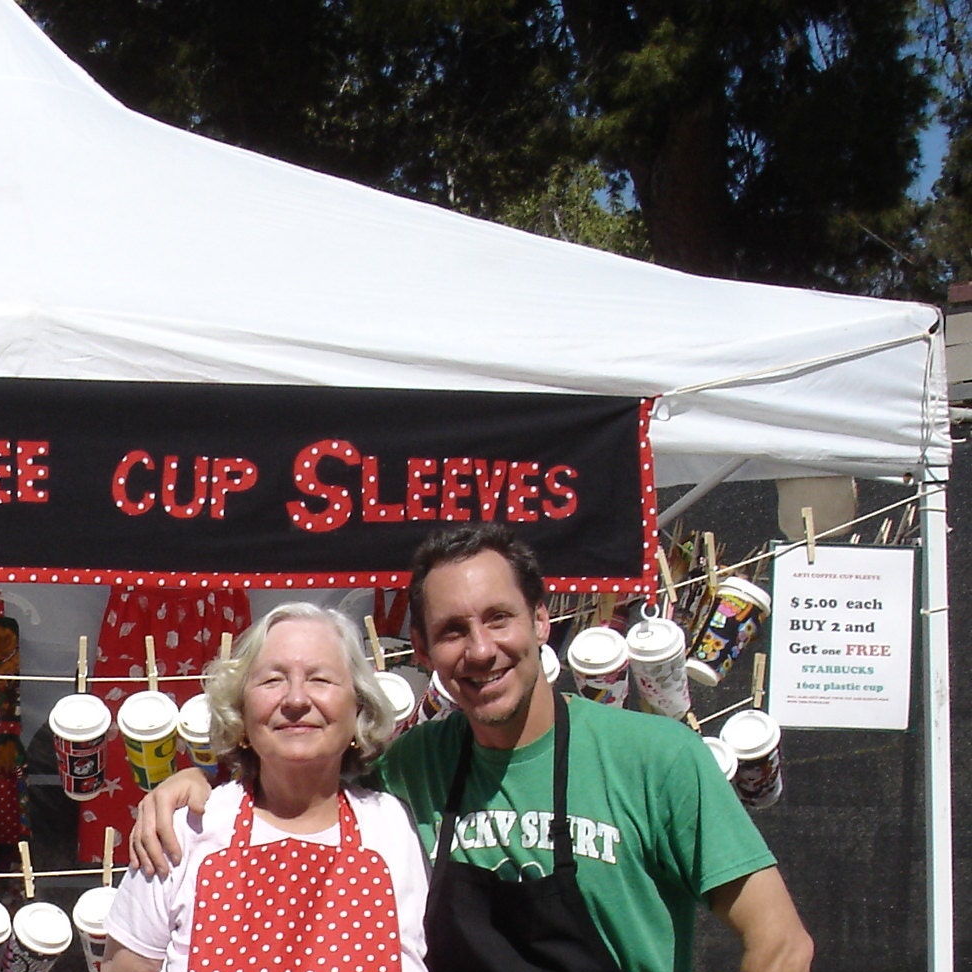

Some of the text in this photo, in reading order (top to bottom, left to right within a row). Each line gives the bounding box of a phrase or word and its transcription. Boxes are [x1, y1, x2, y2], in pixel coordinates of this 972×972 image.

[111, 449, 259, 519] CUP
[286, 438, 579, 533] SLEEVES
[846, 598, 883, 610] each
[789, 619, 875, 633] BUY 2 and
[789, 643, 891, 657] Get one FREE
[801, 664, 875, 675] STARBUCKS
[823, 681, 861, 692] plastic
[863, 684, 884, 693] cup
